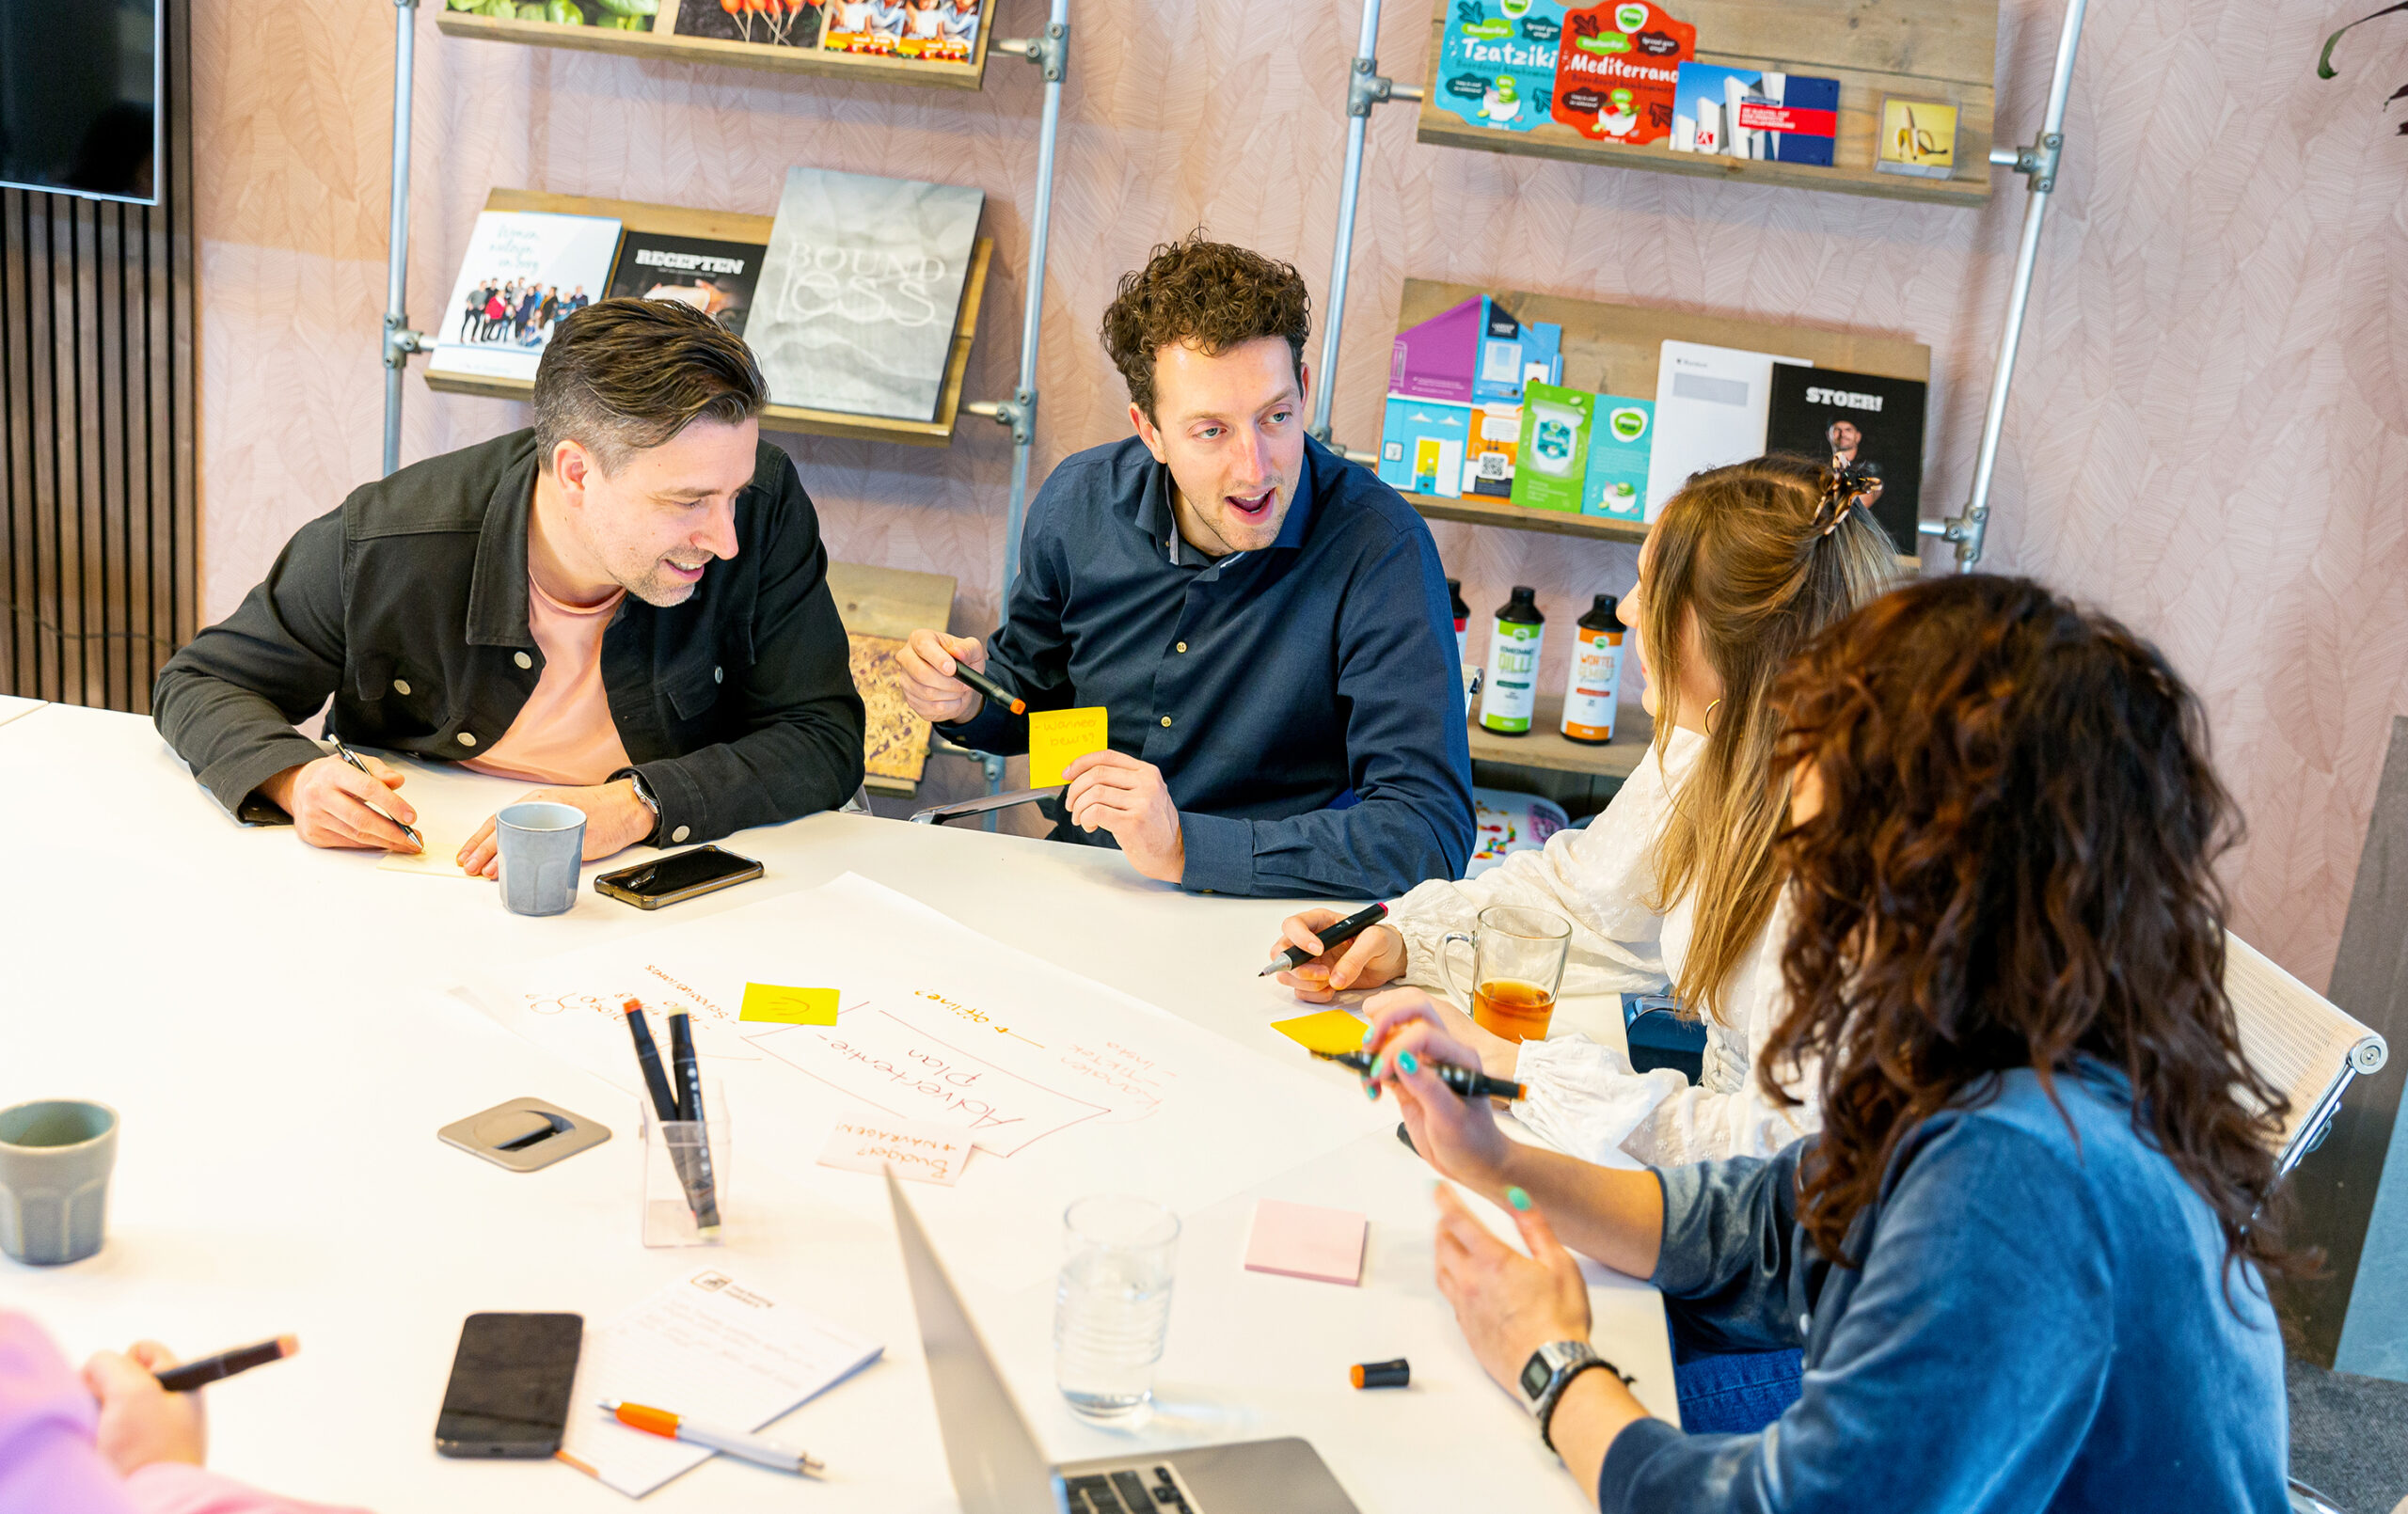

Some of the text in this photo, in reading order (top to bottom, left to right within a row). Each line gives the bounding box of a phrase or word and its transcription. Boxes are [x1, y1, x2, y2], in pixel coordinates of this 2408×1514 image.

[1461, 37, 1559, 69] Tzatziki
[635, 248, 745, 275] RECEPTEN
[788, 241, 946, 283] BOUND
[1805, 386, 1884, 412] STOER!
